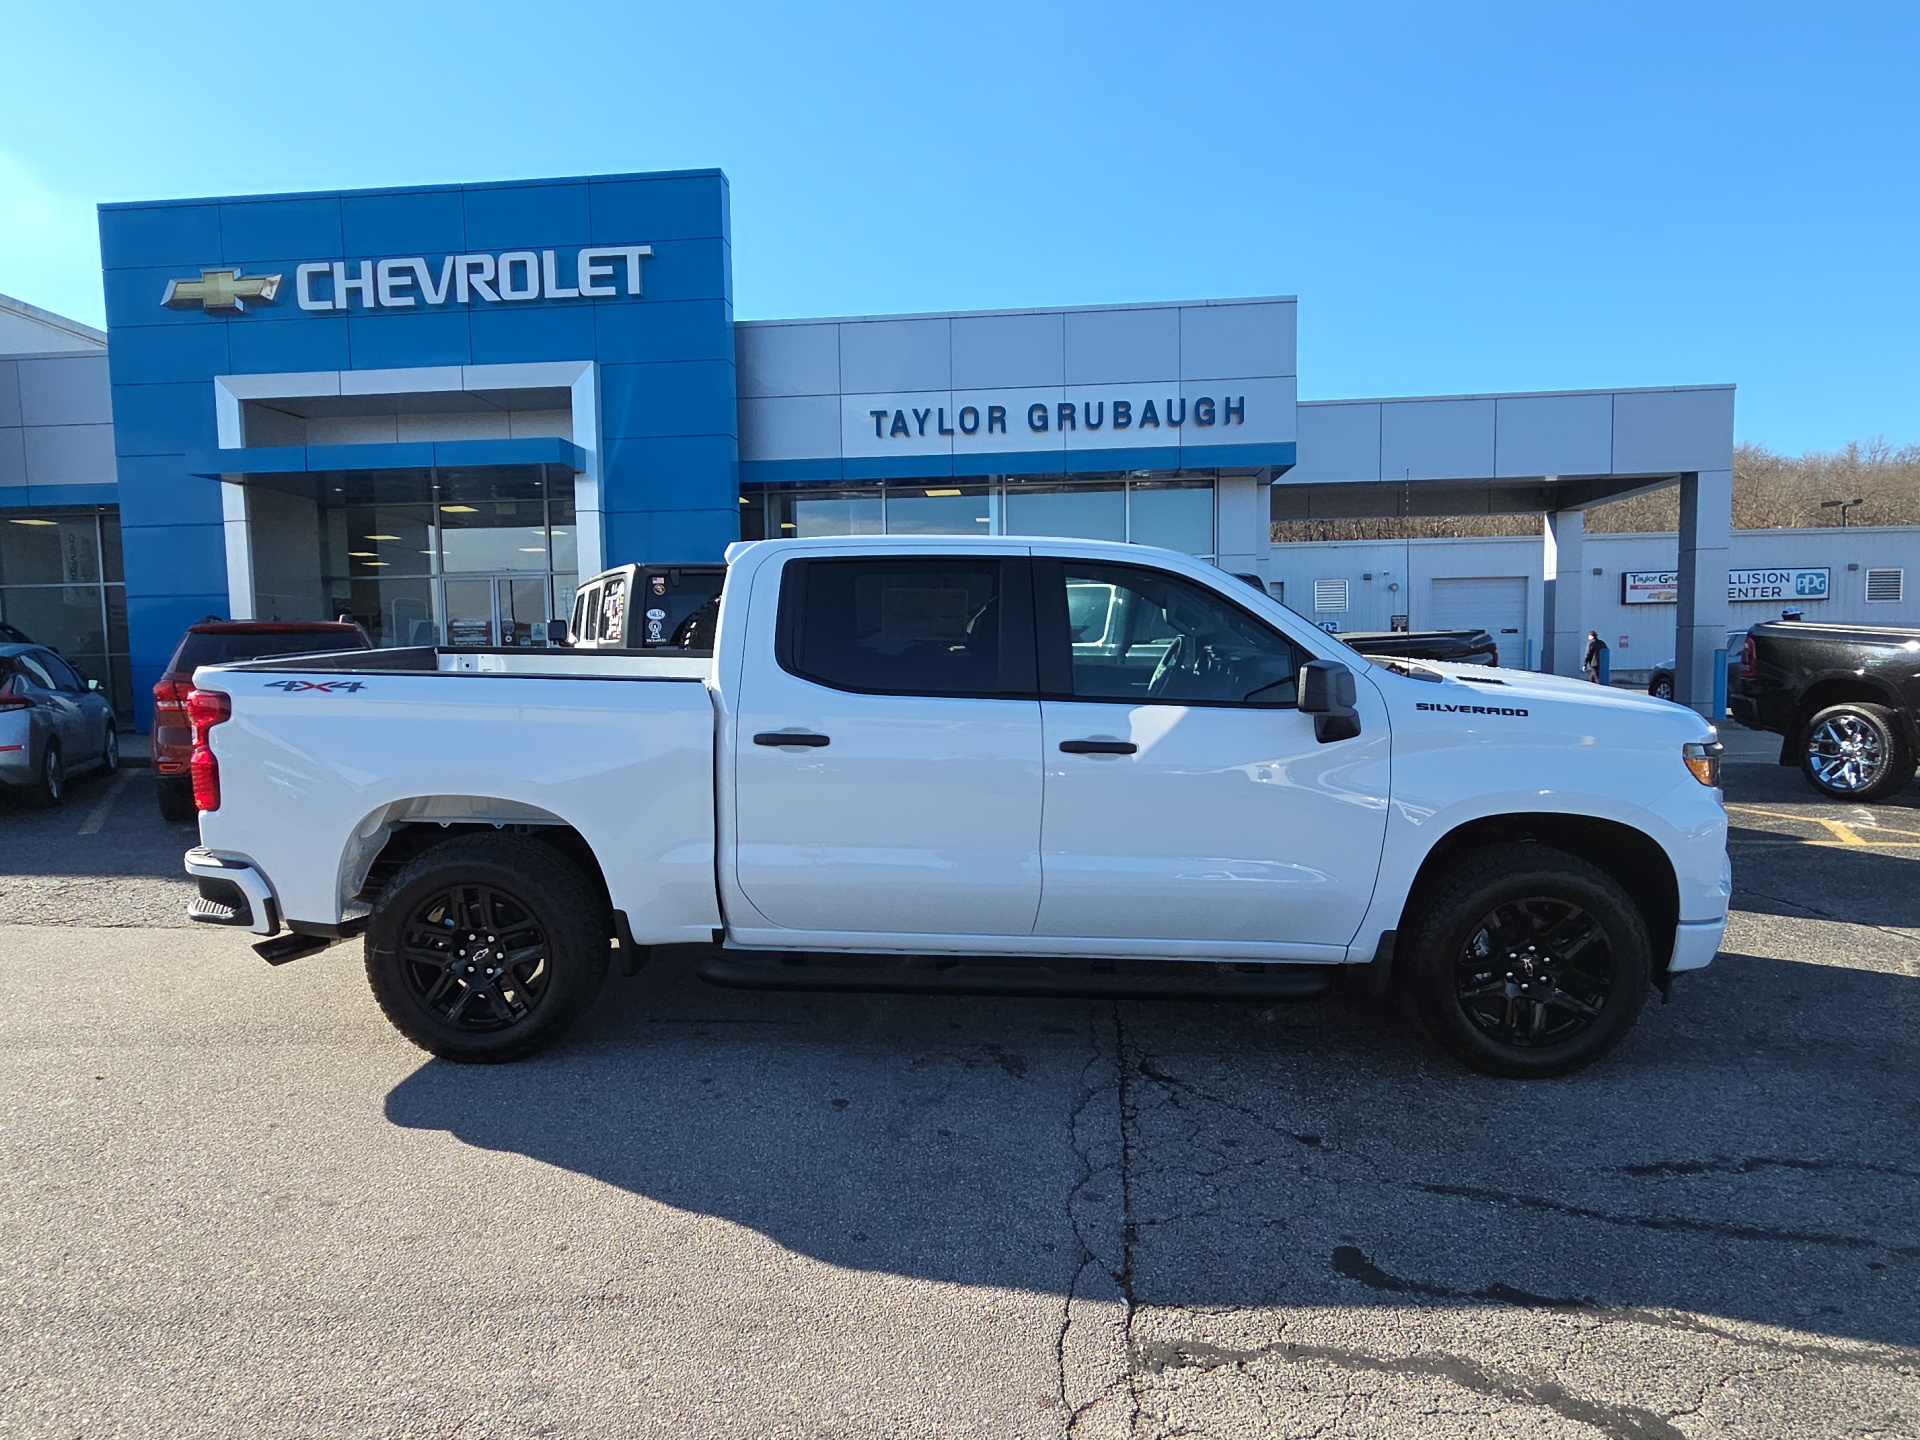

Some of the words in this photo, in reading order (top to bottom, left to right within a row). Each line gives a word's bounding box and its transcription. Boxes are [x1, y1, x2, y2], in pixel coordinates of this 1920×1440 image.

[296, 246, 652, 310] CHEVROLET
[870, 405, 1007, 437] TAYLOR
[1027, 396, 1245, 432] GRUBAUGH
[1630, 574, 1657, 584] Taylor
[1797, 574, 1825, 594] PPG
[1416, 703, 1528, 717] SILVERADO
